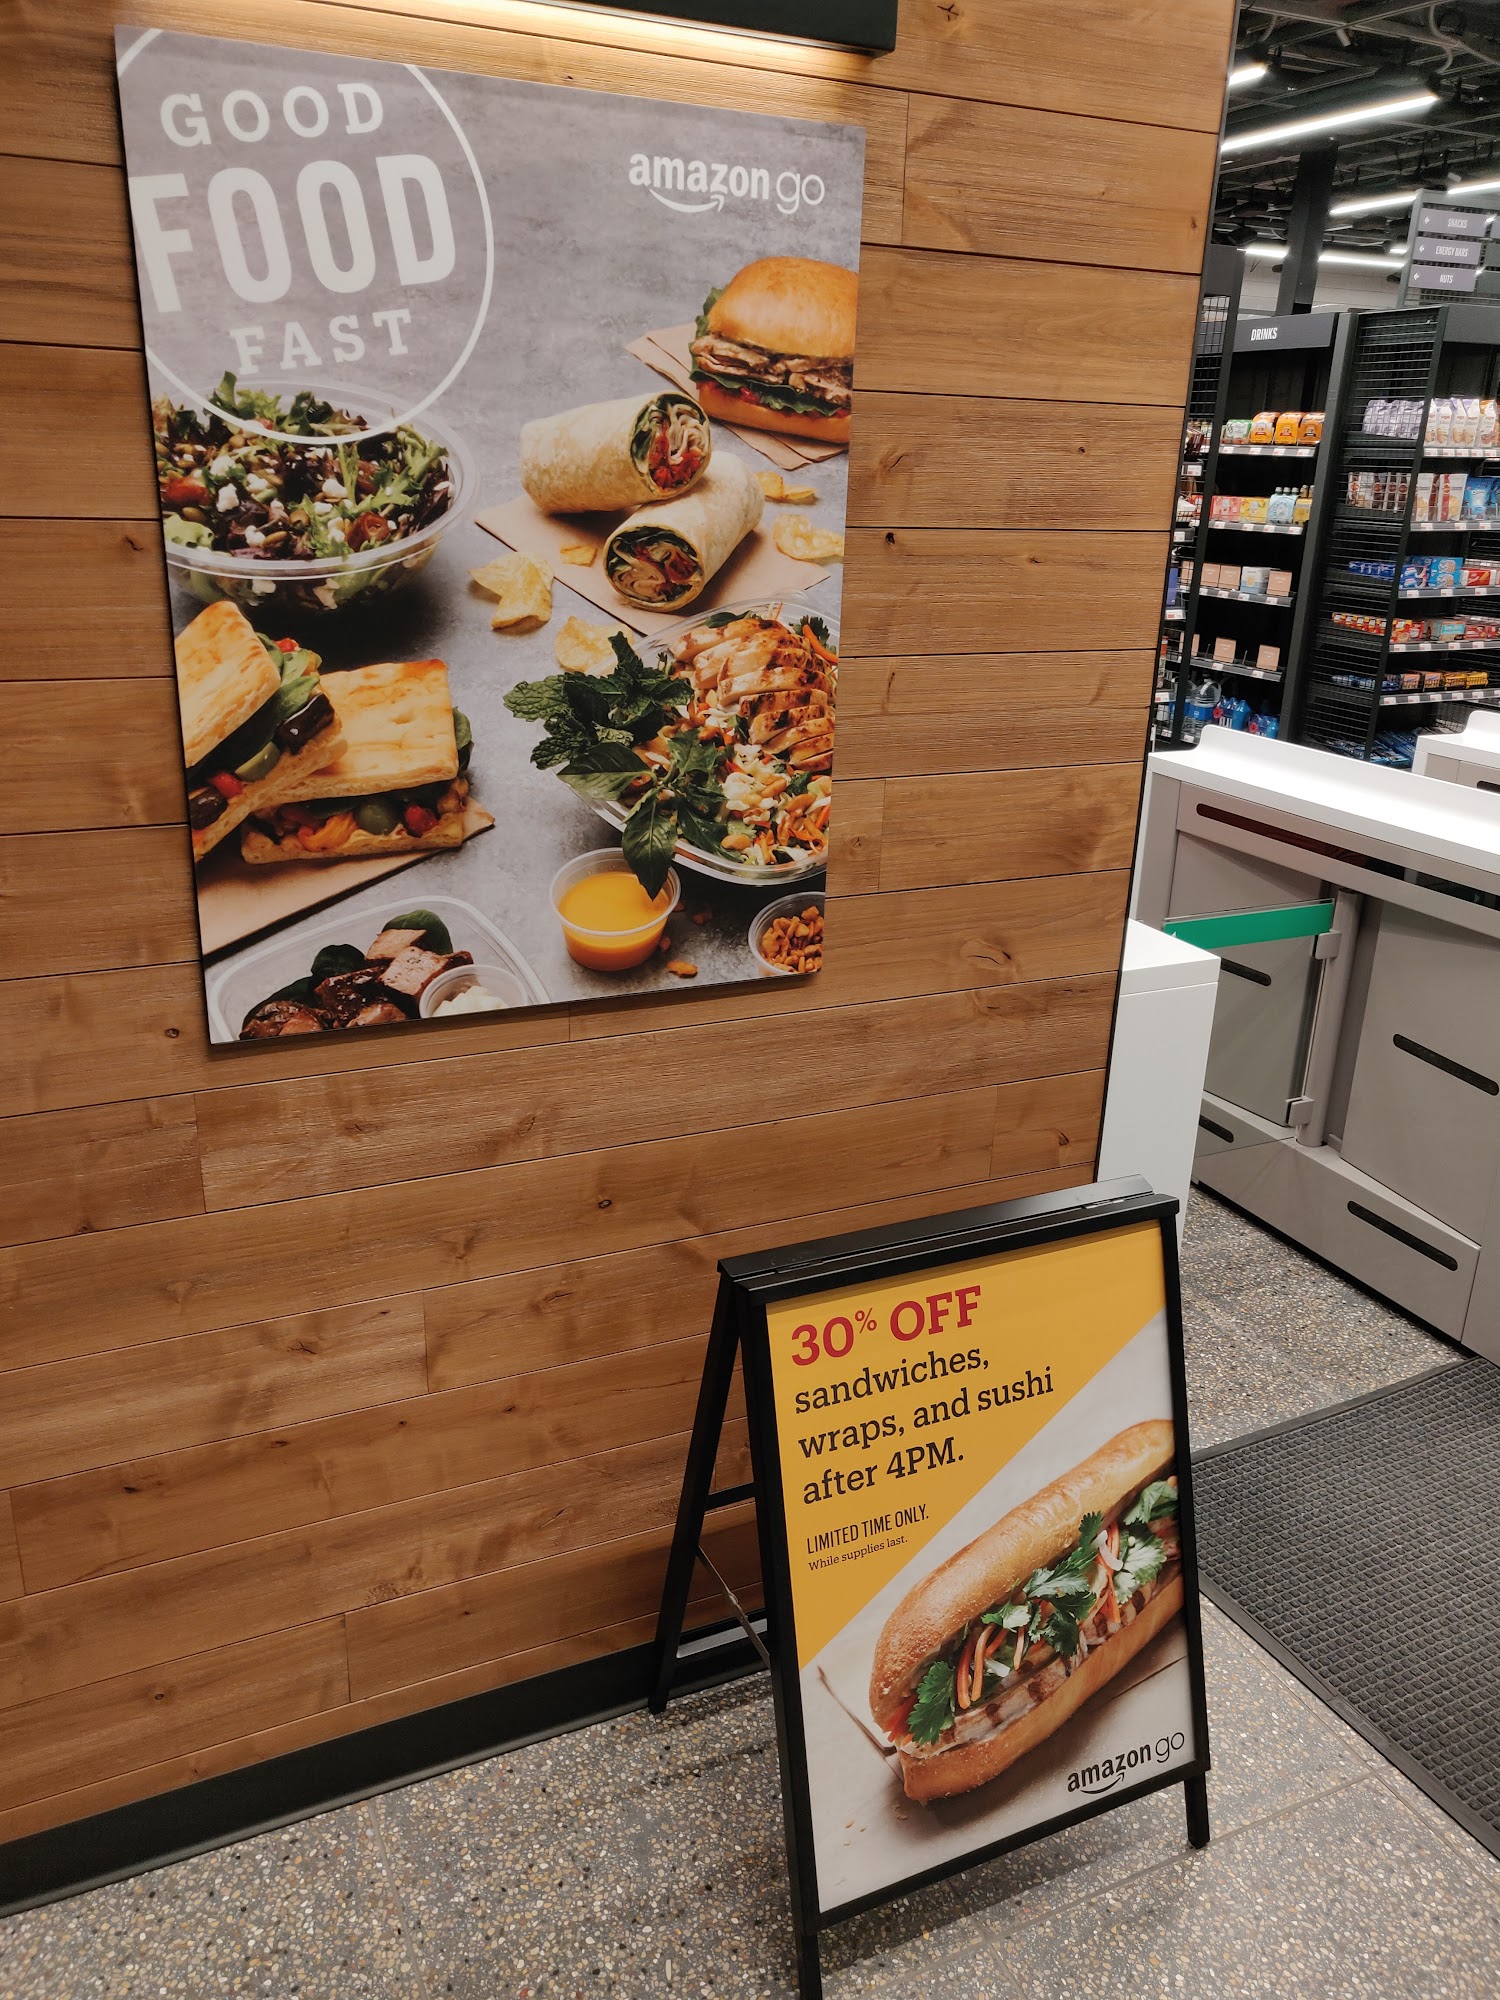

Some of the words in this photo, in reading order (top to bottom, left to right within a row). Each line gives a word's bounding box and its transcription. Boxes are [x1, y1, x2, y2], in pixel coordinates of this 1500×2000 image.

[160, 82, 384, 147] GOOD
[629, 153, 770, 201] amazon
[776, 171, 825, 214] go
[128, 154, 456, 313] FOOD
[1435, 245, 1455, 256] ENERGY
[1455, 247, 1469, 257] BARS
[1447, 218, 1468, 229] SNACKS
[1439, 274, 1454, 284] NUTS
[230, 309, 412, 375] FAST
[1250, 327, 1278, 341] DRINKS
[791, 1307, 878, 1367] 30%
[889, 1284, 981, 1343] OFF
[795, 1347, 990, 1415] sandwiches,
[798, 1413, 905, 1460] wraps,
[913, 1387, 971, 1429] and
[977, 1366, 1054, 1412] sushi
[802, 1463, 879, 1505] after
[886, 1436, 965, 1480] 4PM.
[807, 1524, 859, 1555] LIMITED
[861, 1514, 893, 1538] TIME
[894, 1503, 929, 1528] ONLY.
[808, 1555, 840, 1571] While
[842, 1541, 885, 1563] supplies
[886, 1535, 908, 1548] last.
[1067, 1744, 1152, 1793] amazon
[1155, 1732, 1185, 1764] go
